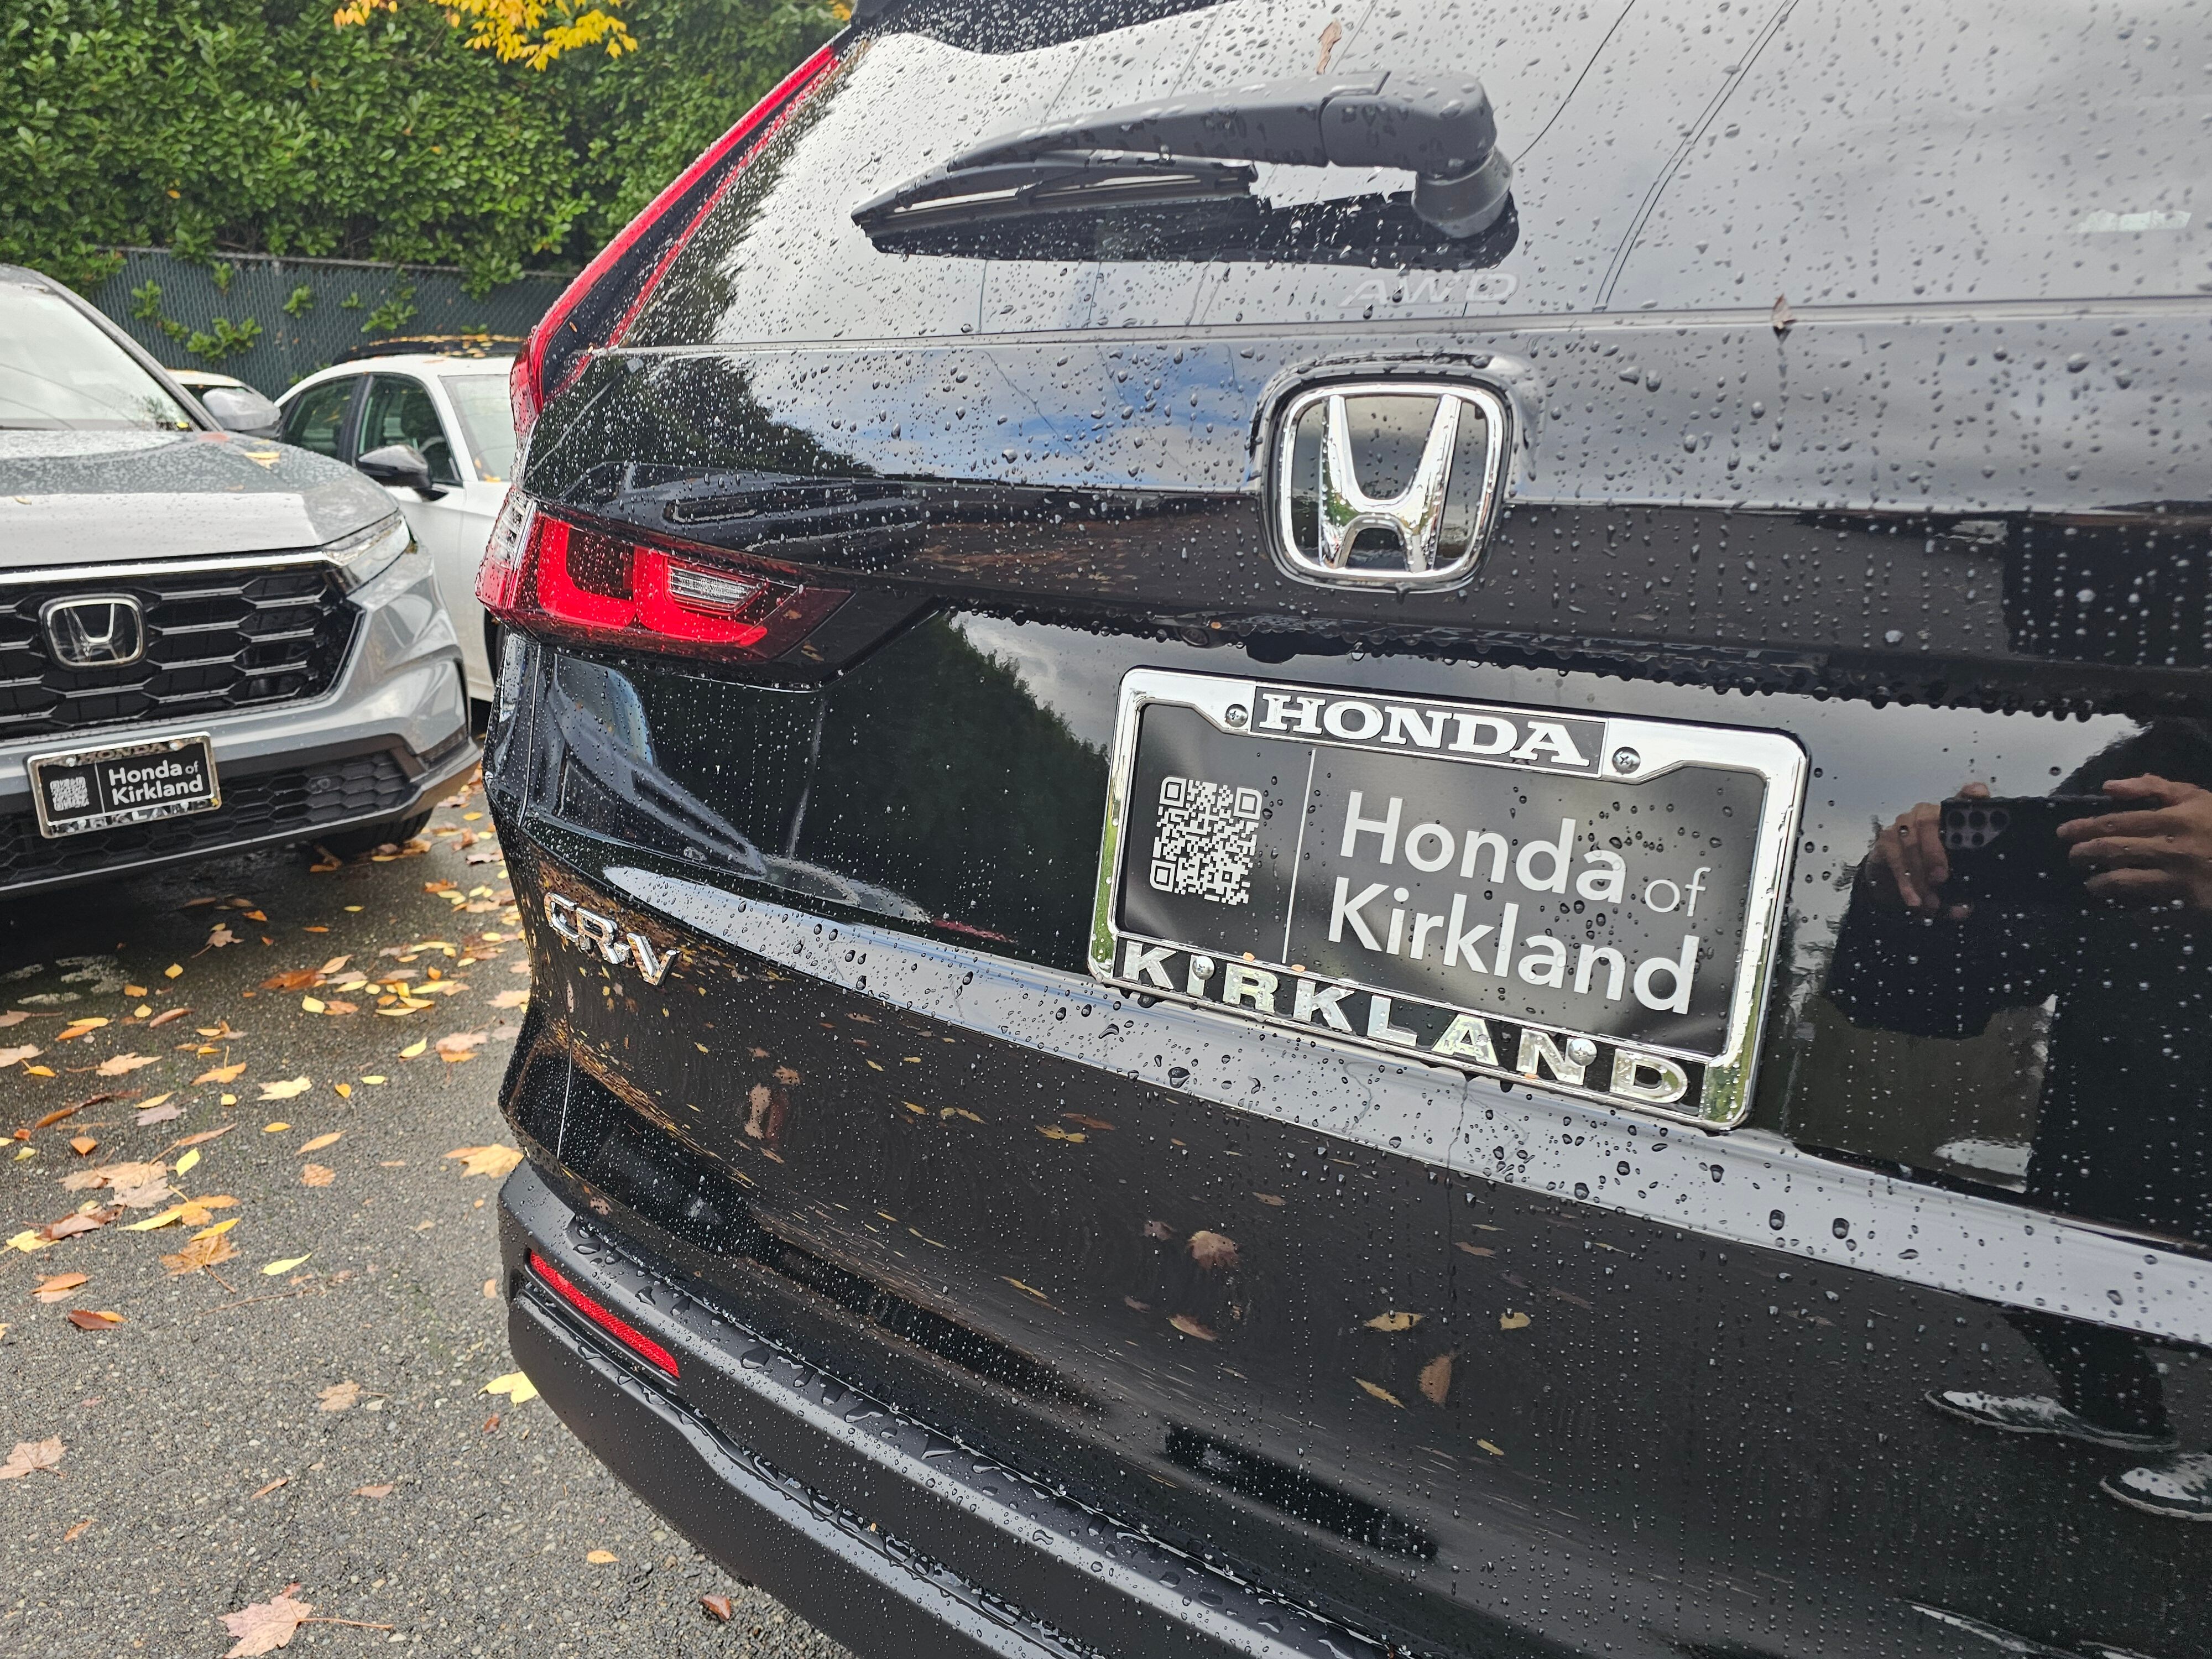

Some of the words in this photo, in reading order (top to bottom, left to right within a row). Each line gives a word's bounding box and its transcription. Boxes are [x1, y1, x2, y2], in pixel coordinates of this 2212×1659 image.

[1338, 273, 1520, 307] AWD
[1260, 693, 1591, 768] HONDA
[108, 759, 183, 786] Honda
[185, 760, 199, 775] of
[112, 774, 204, 805] Kirkland
[1340, 790, 1627, 904] Honda
[1644, 867, 1711, 917] of
[1328, 877, 1699, 1015] Kirkland
[1122, 940, 1688, 1103] KIRKLAND
